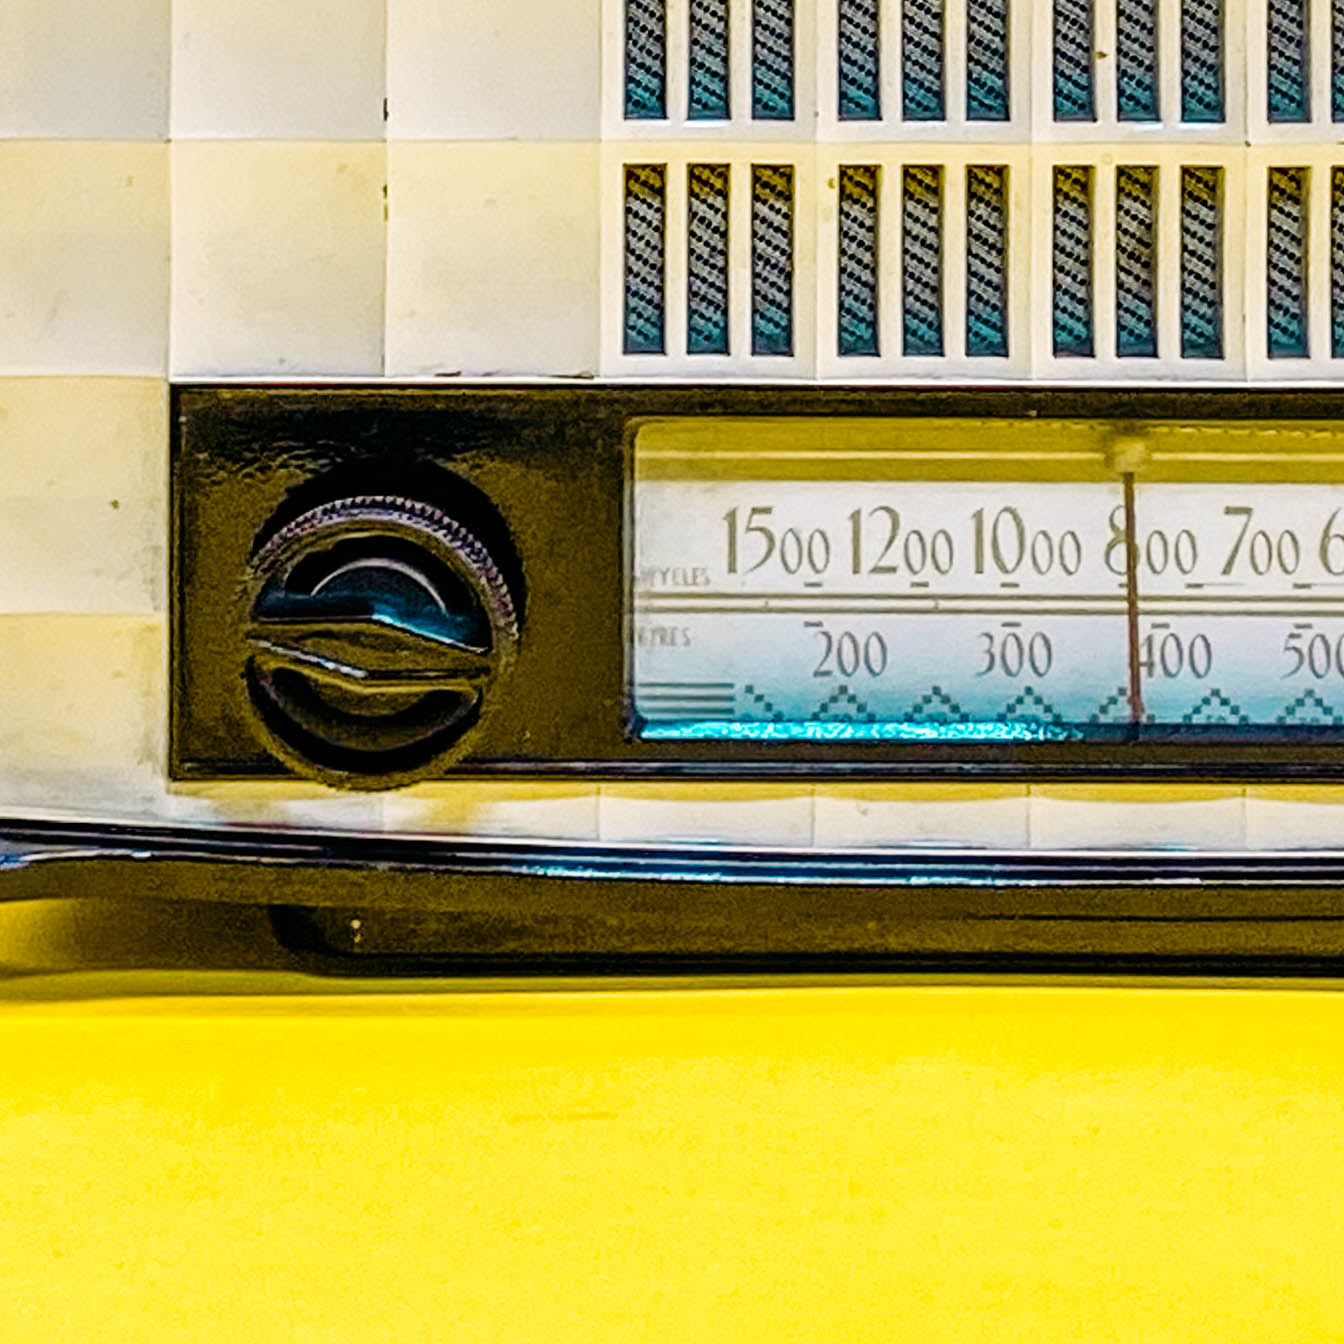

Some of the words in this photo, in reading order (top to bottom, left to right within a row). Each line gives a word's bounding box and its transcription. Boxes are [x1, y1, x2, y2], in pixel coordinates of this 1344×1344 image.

[722, 506, 830, 575] 1500
[848, 506, 954, 575] 1200
[970, 506, 1081, 575] 1000
[1221, 505, 1300, 576] 700
[812, 631, 888, 679] 200
[975, 632, 1053, 678] 300
